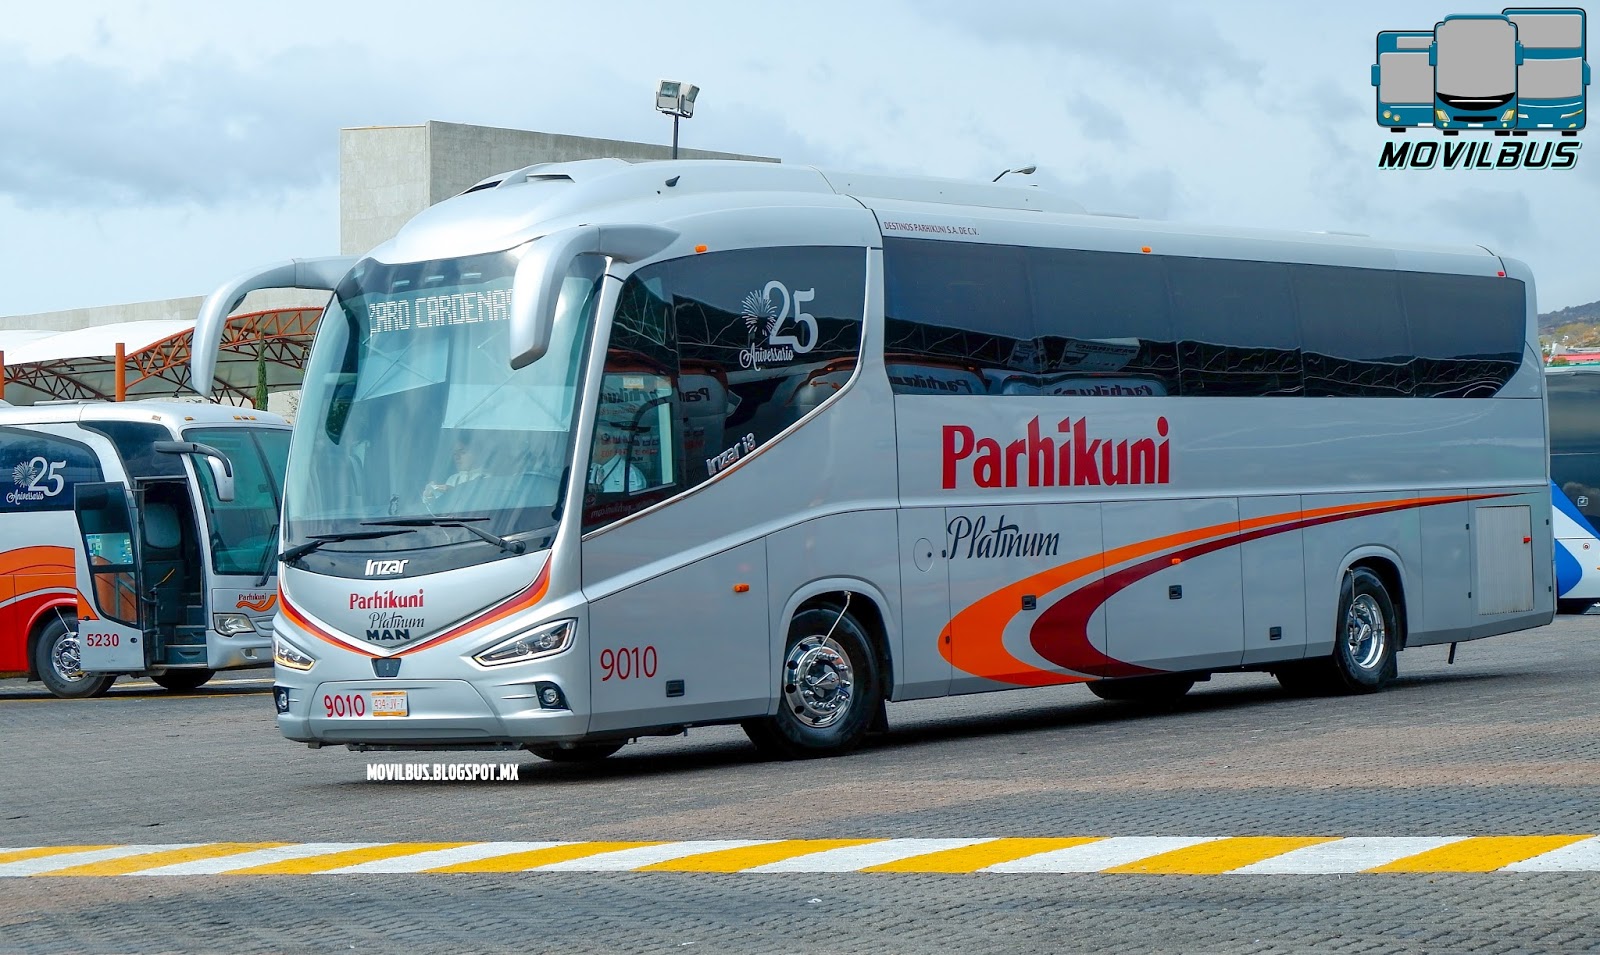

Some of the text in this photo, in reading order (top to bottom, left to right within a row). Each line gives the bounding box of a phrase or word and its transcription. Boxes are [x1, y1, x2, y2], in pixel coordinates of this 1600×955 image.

[883, 221, 914, 232] DESTINOS
[914, 223, 947, 234] PARHIKUNI
[959, 226, 968, 235] DE
[763, 280, 819, 354] 25
[706, 441, 741, 477] Irizar
[741, 432, 756, 455] i8
[942, 414, 1170, 489] Parhikuni
[27, 456, 67, 497] 25
[946, 514, 1060, 560] Platinum
[364, 559, 410, 577] Irizar
[349, 588, 425, 610] Parhikuni
[368, 612, 425, 630] Platinum
[86, 632, 120, 648] 5230
[366, 628, 411, 641] MAN
[600, 645, 658, 682] 9010
[323, 693, 366, 718] 9010
